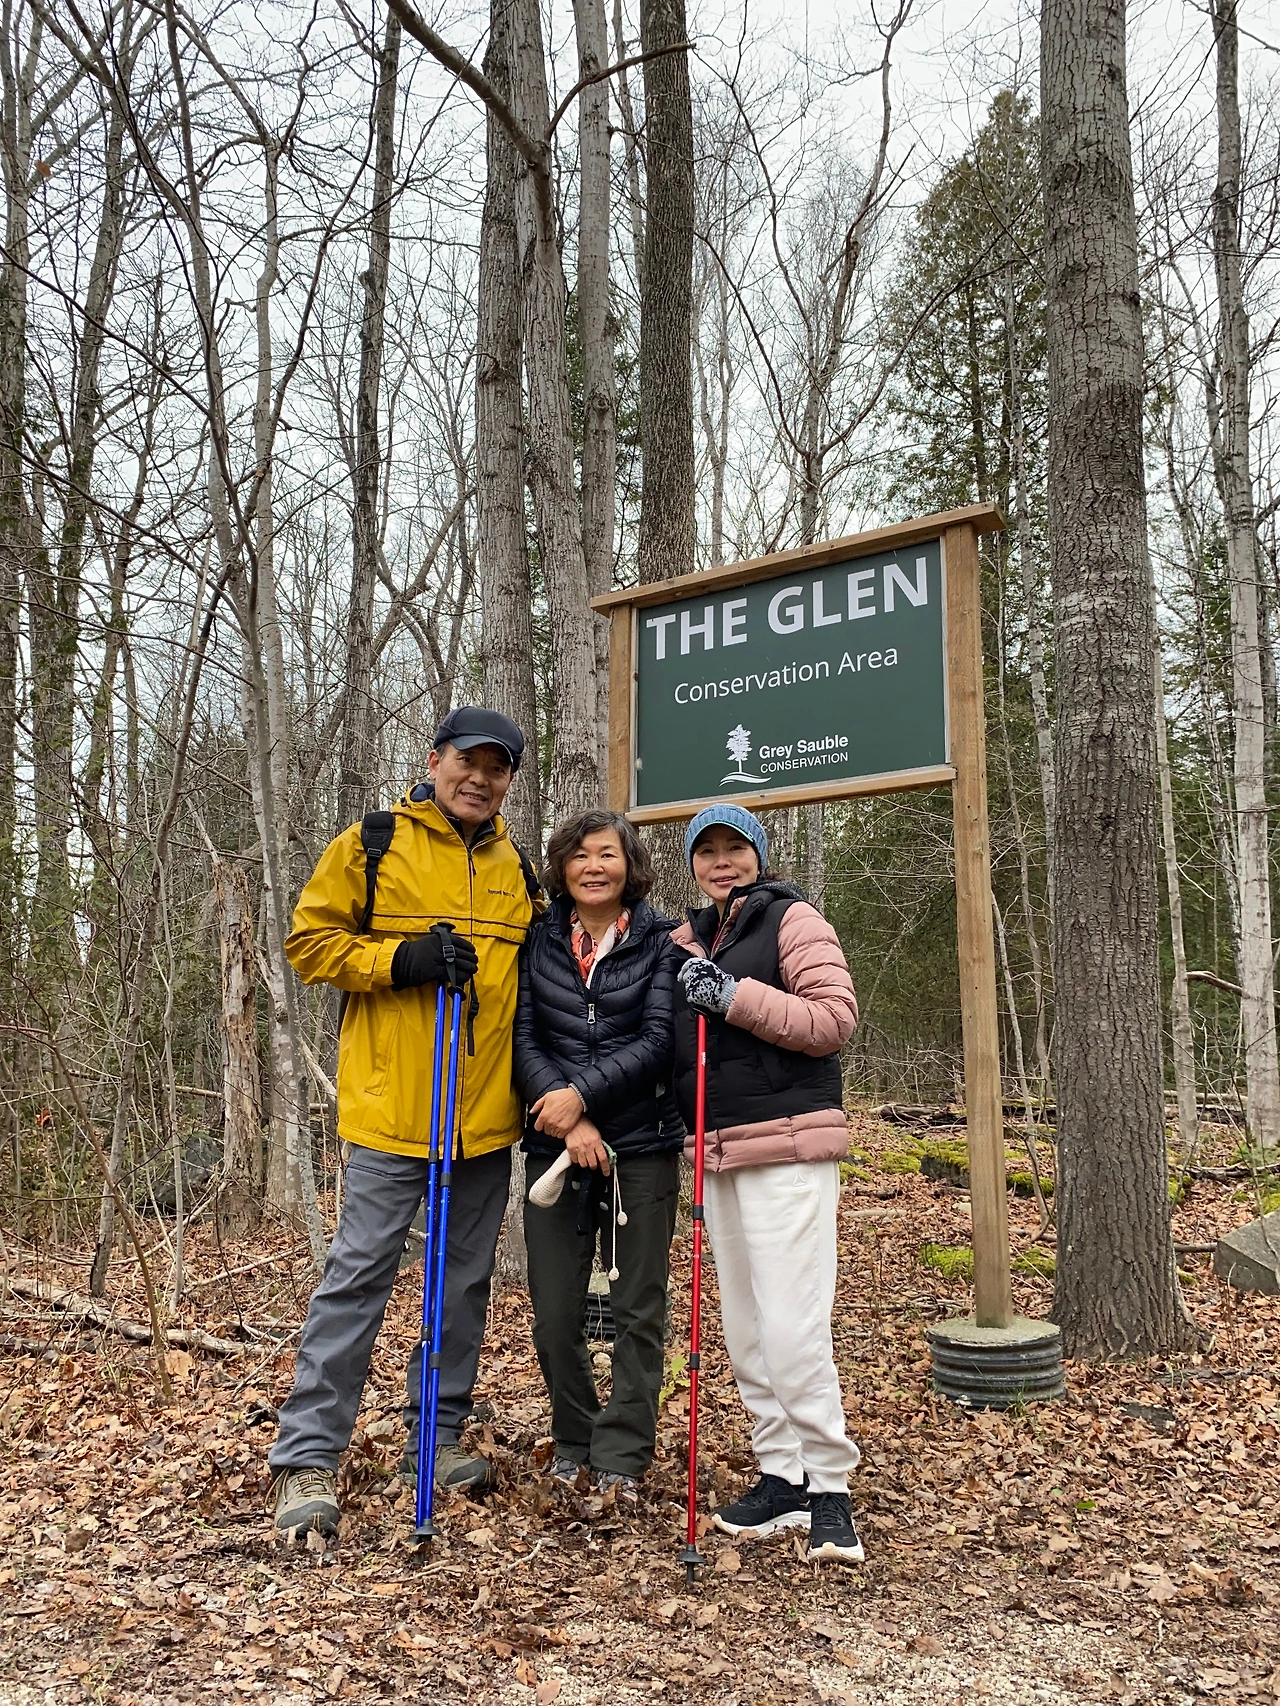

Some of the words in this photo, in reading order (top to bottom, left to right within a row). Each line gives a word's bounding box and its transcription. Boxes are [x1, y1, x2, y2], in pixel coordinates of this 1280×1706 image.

[646, 597, 748, 660] THE
[767, 557, 928, 635] GLEN
[674, 661, 830, 704] Conservation
[837, 647, 898, 676] Area
[759, 744, 794, 760] Grey
[796, 734, 849, 754] Sauble
[760, 751, 849, 774] CONSERVATION
